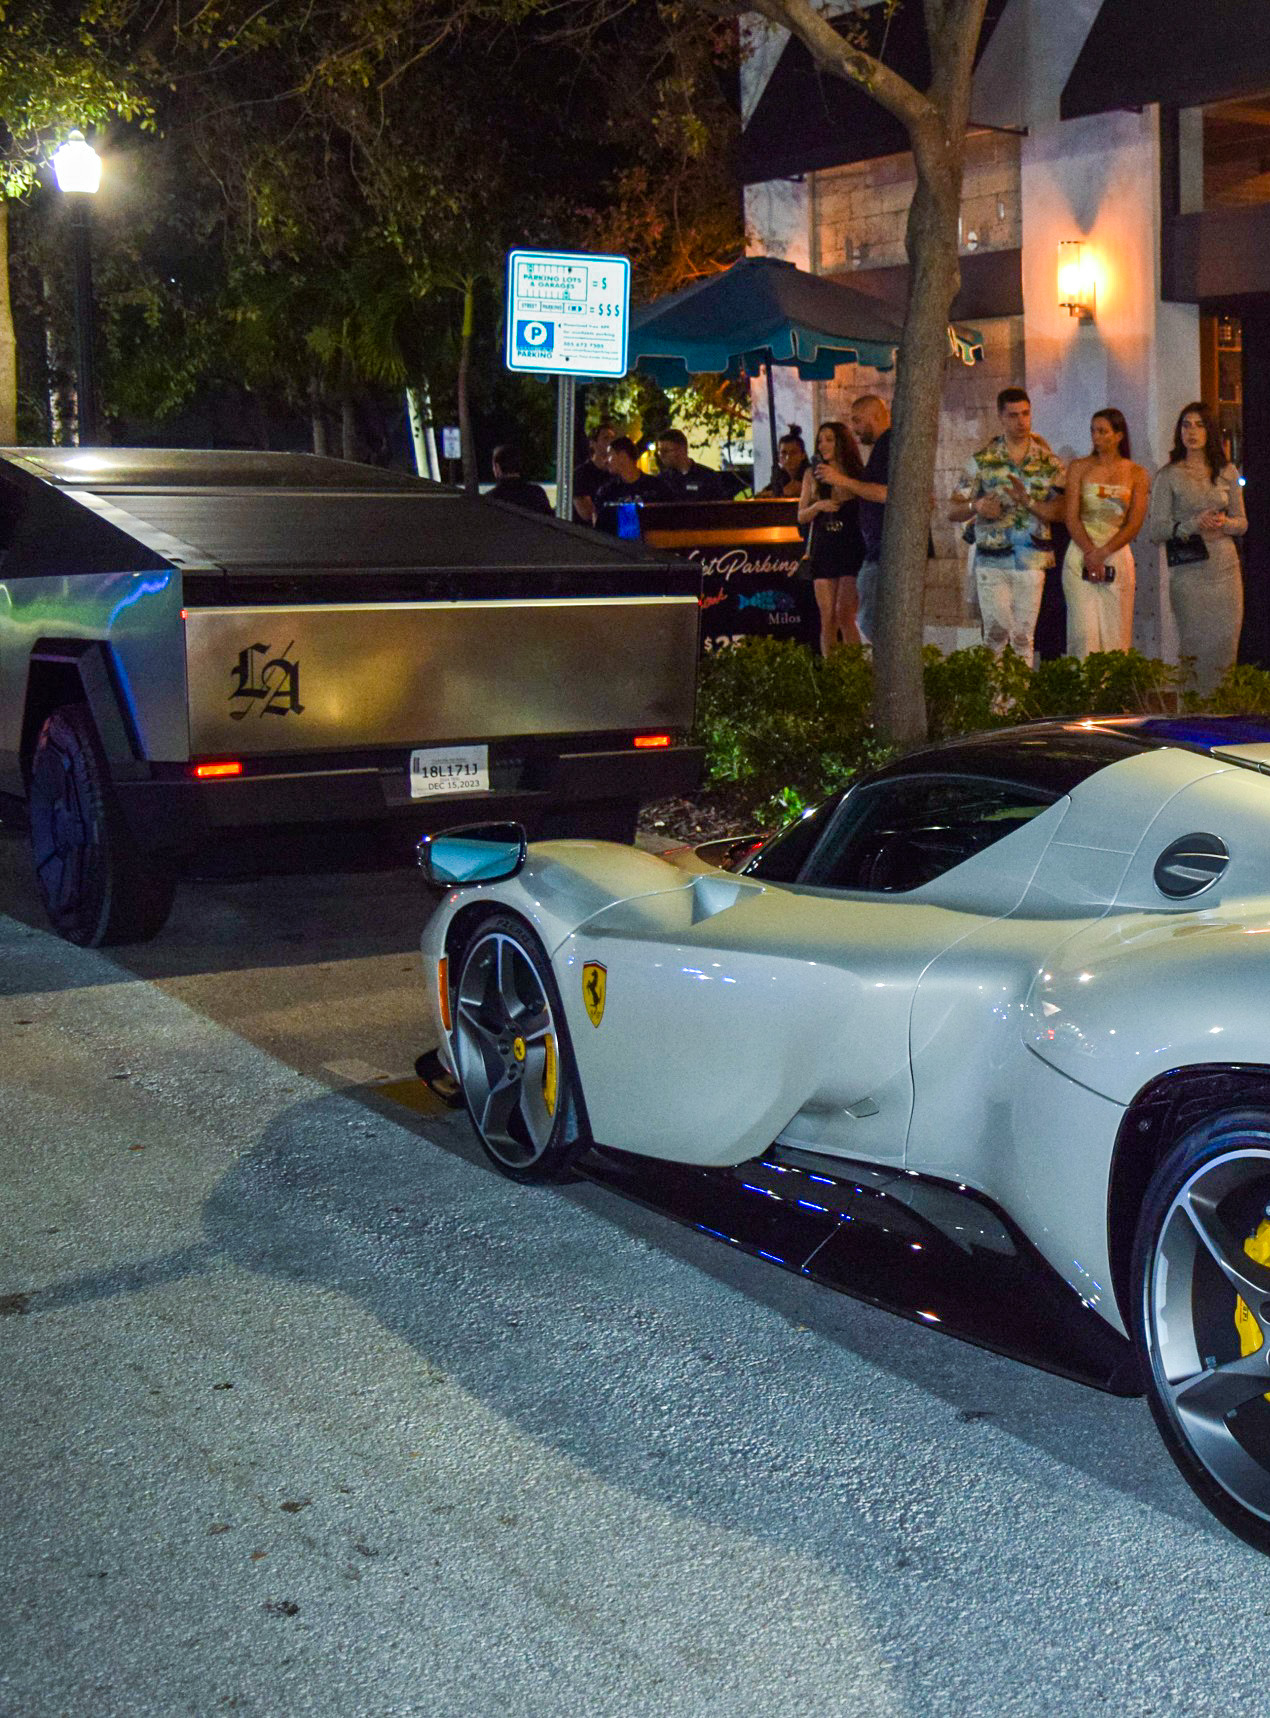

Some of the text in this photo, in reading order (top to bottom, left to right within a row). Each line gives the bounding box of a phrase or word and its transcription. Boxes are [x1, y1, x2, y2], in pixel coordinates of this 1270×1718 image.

[523, 274, 560, 282] PARKING
[601, 277, 608, 290] $
[538, 281, 575, 290] GARAGES
[517, 351, 553, 360] PARKING
[716, 549, 800, 581] Parking
[768, 612, 802, 625] Milos
[422, 763, 478, 779] 18L171J
[428, 782, 445, 791] DEC
